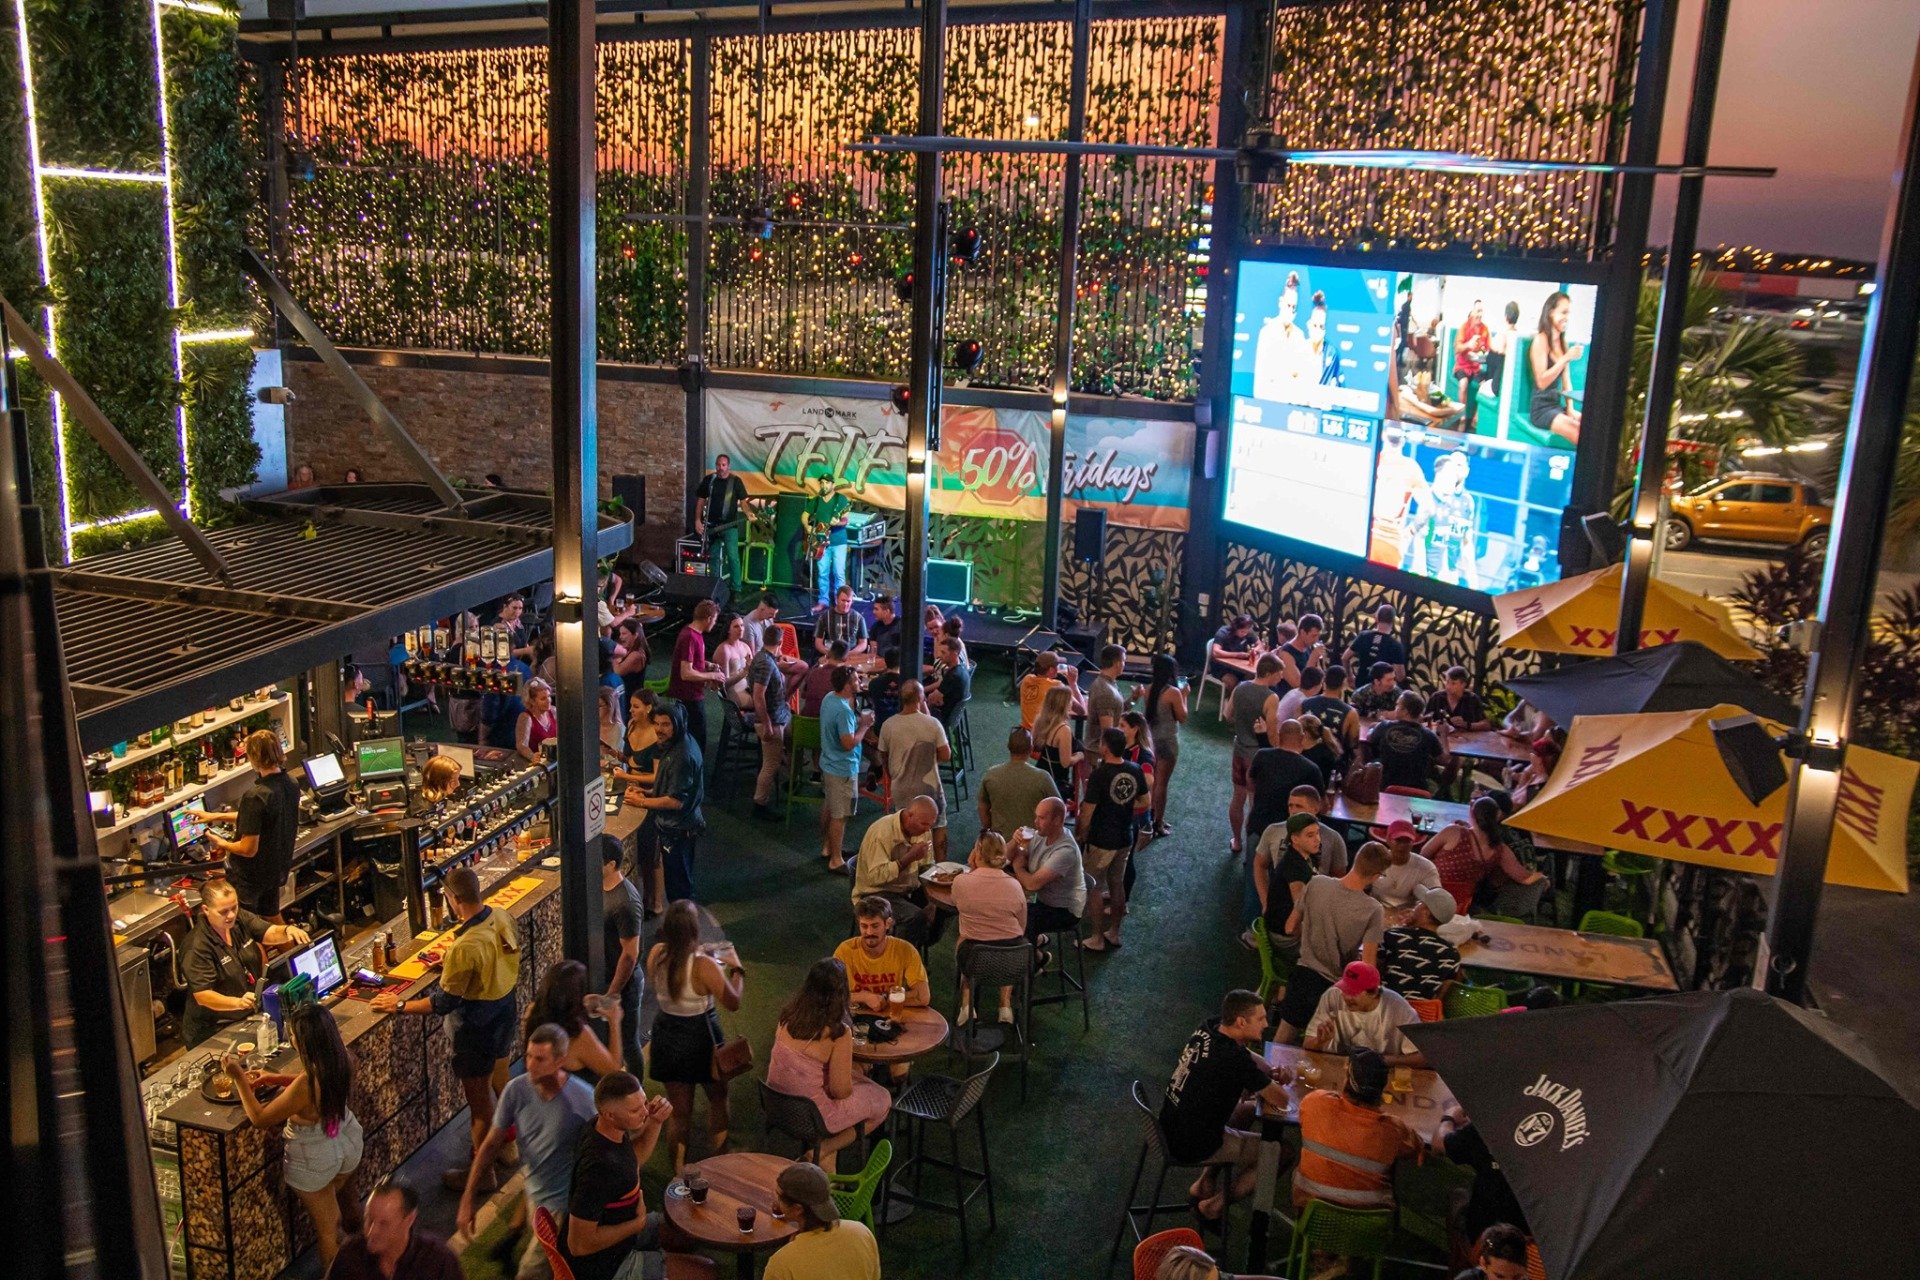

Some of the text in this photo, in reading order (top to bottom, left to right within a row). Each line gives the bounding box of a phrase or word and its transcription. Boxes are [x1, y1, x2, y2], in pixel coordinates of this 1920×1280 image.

[962, 441, 1036, 491] 50%
[1042, 449, 1158, 503] ridays
[1613, 799, 1782, 860] XXXX
[1523, 1074, 1569, 1104] JACK
